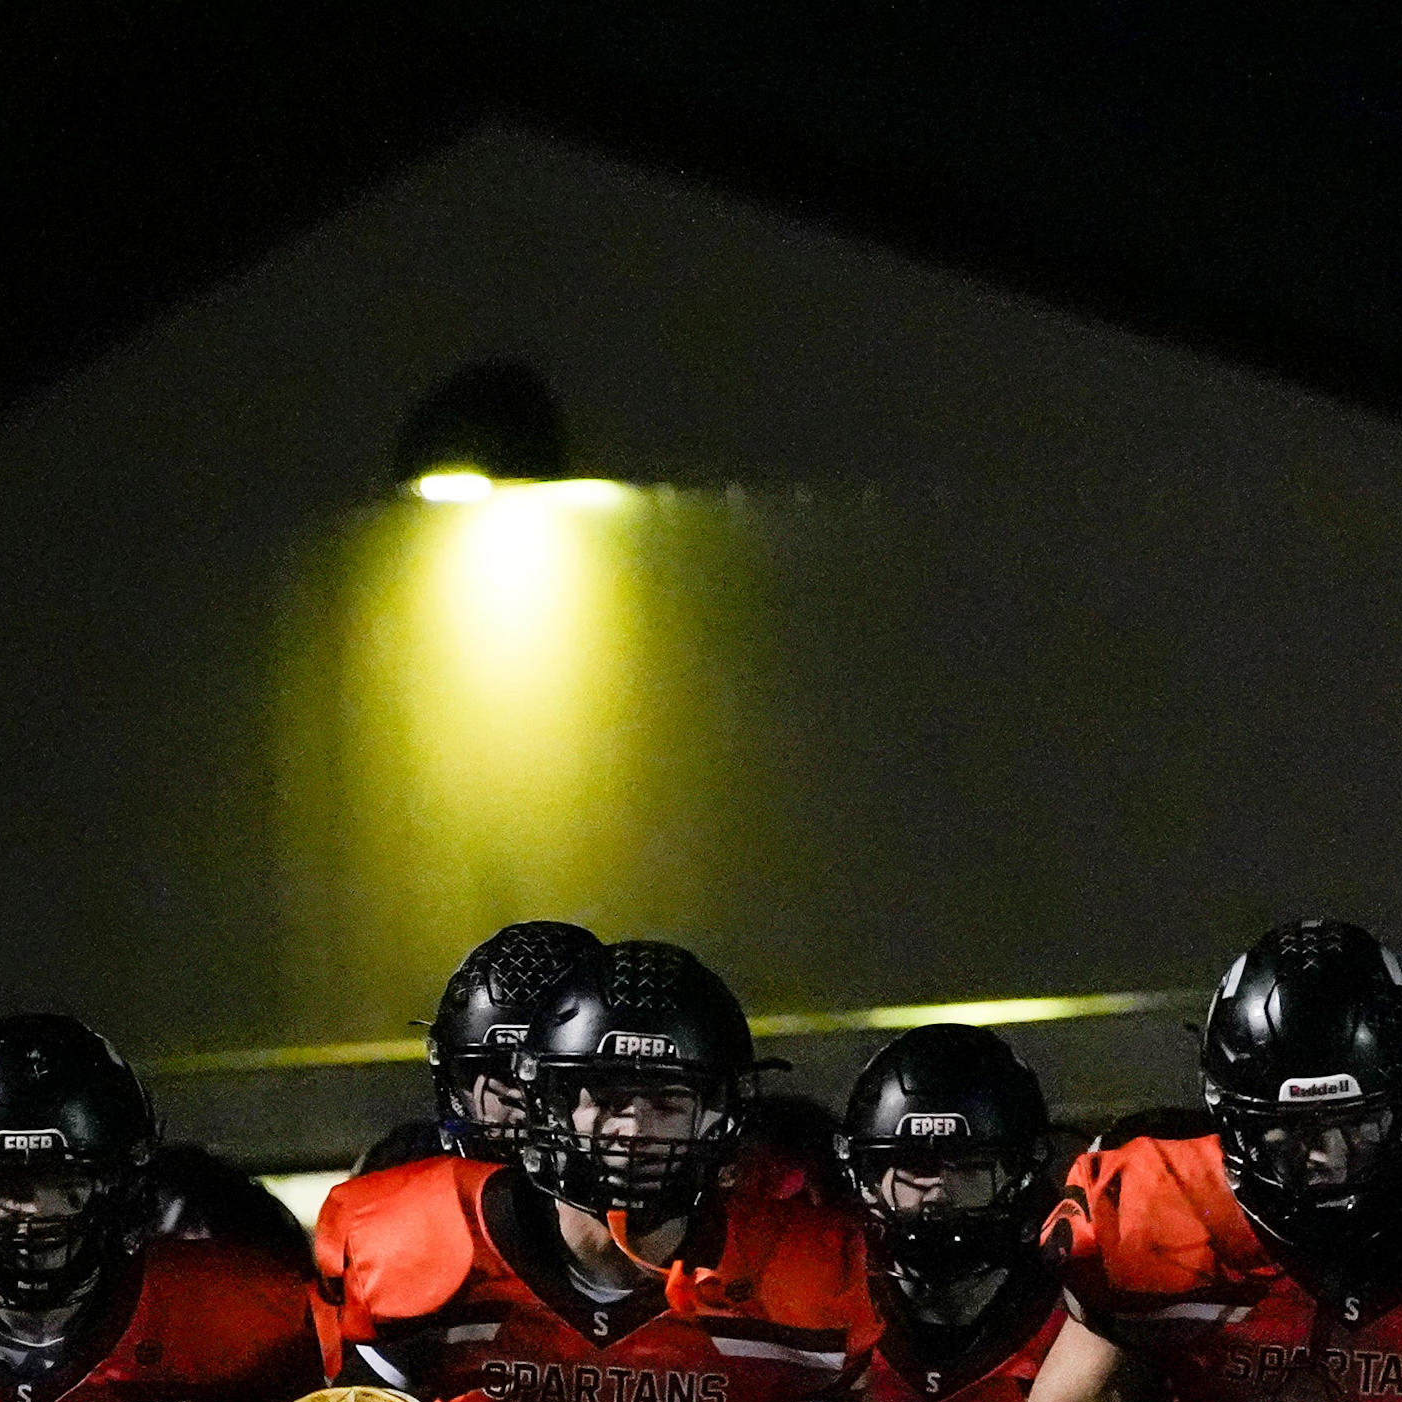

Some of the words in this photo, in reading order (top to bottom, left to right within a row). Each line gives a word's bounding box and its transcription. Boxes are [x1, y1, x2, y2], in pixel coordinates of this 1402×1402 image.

[910, 1117, 957, 1136] EPEP
[1342, 1296, 1361, 1323] S
[592, 1310, 610, 1337] S
[925, 1371, 942, 1395] S
